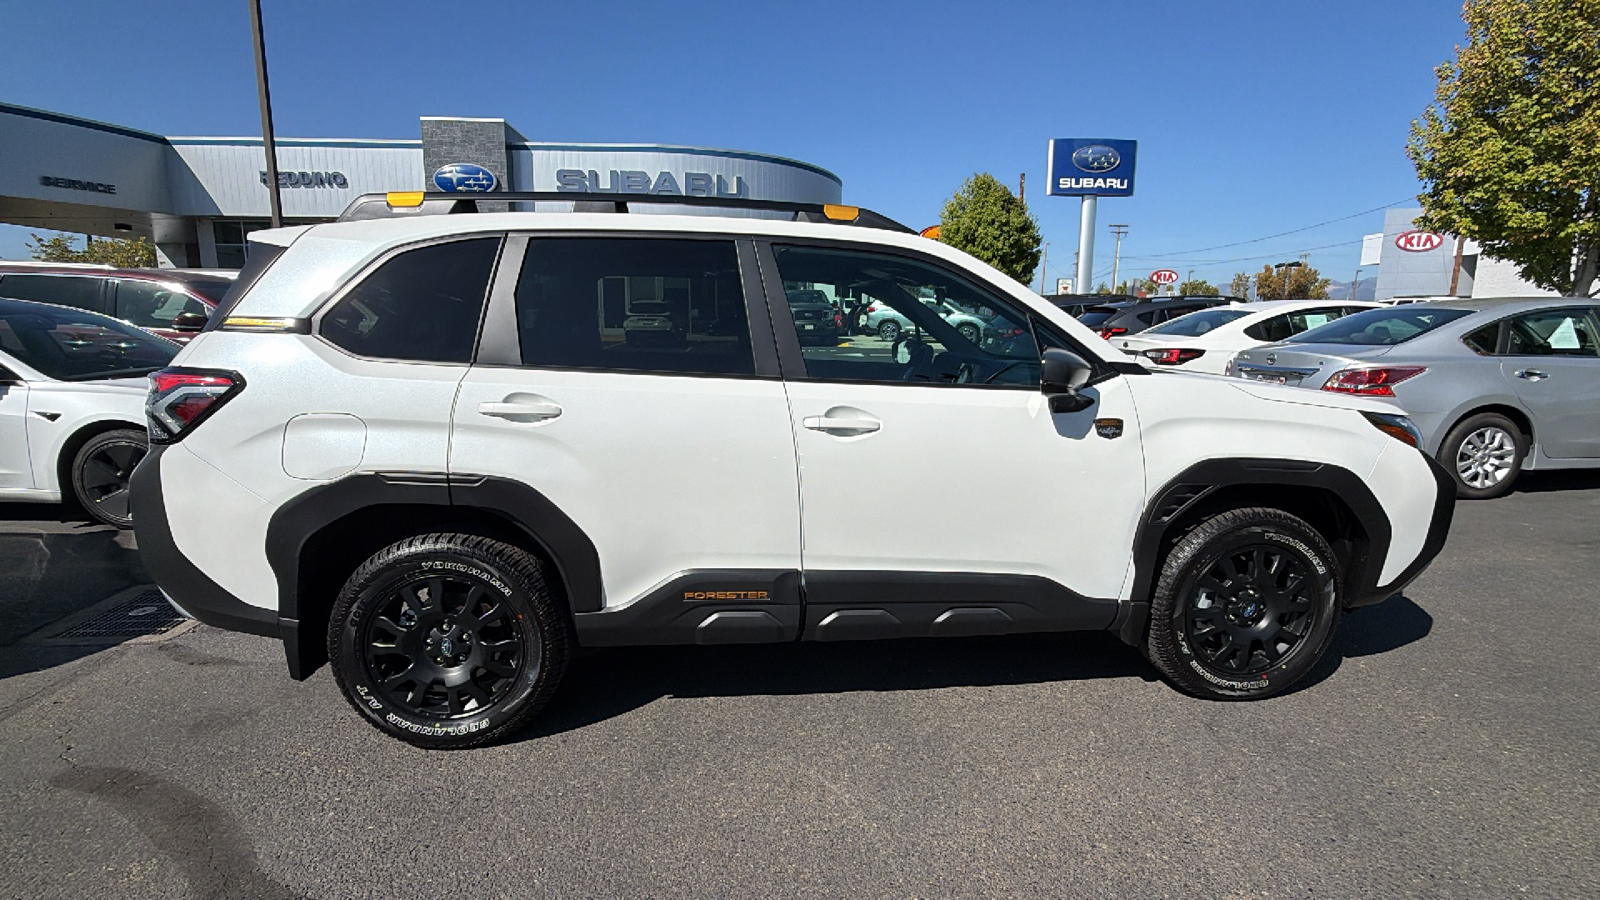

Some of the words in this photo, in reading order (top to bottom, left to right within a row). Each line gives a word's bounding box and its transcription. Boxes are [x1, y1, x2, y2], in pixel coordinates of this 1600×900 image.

[39, 176, 117, 195] SERVICE
[557, 169, 747, 198] SUBARU
[1059, 178, 1128, 190] SUBARU
[1403, 234, 1436, 248] KIA
[1156, 272, 1175, 283] KIA
[1264, 532, 1327, 575] YOKOHAMA
[421, 561, 513, 597] YOKOHAMA
[684, 591, 769, 600] FORESTER
[356, 685, 383, 710] A/T
[386, 713, 490, 737] GEOLANDAR
